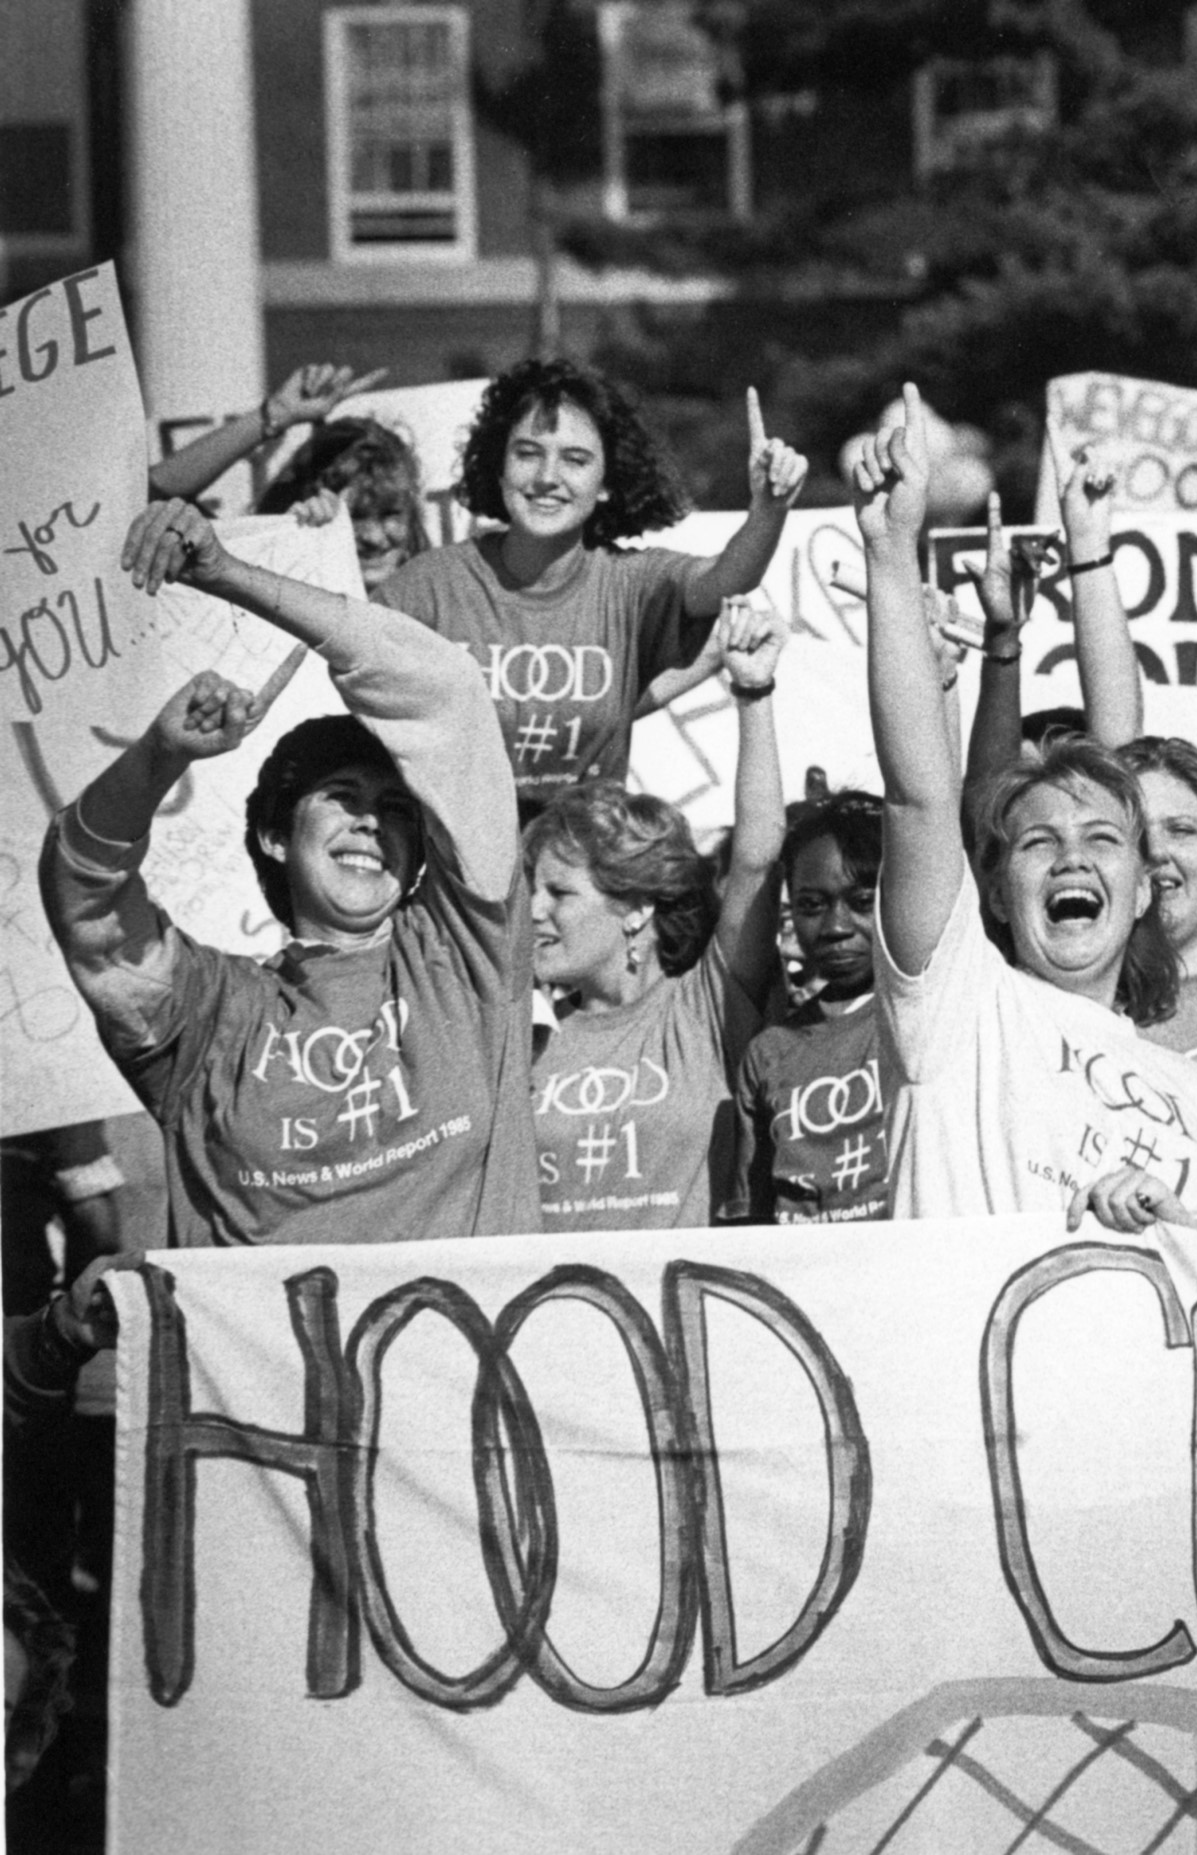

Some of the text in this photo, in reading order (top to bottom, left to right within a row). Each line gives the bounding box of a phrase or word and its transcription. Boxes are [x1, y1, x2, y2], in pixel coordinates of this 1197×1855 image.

[3, 500, 101, 575] for
[513, 713, 582, 764] #1
[280, 1065, 420, 1150] IS #1
[238, 1170, 269, 1187] U.S.
[272, 1171, 318, 1187] News
[320, 1166, 333, 1182] &
[335, 1155, 384, 1180] World
[385, 1129, 440, 1165] Report
[538, 1119, 643, 1185] S #1
[1027, 1159, 1056, 1184] U.S.
[1078, 1123, 1107, 1169] IS
[136, 1260, 872, 1714] HOOD
